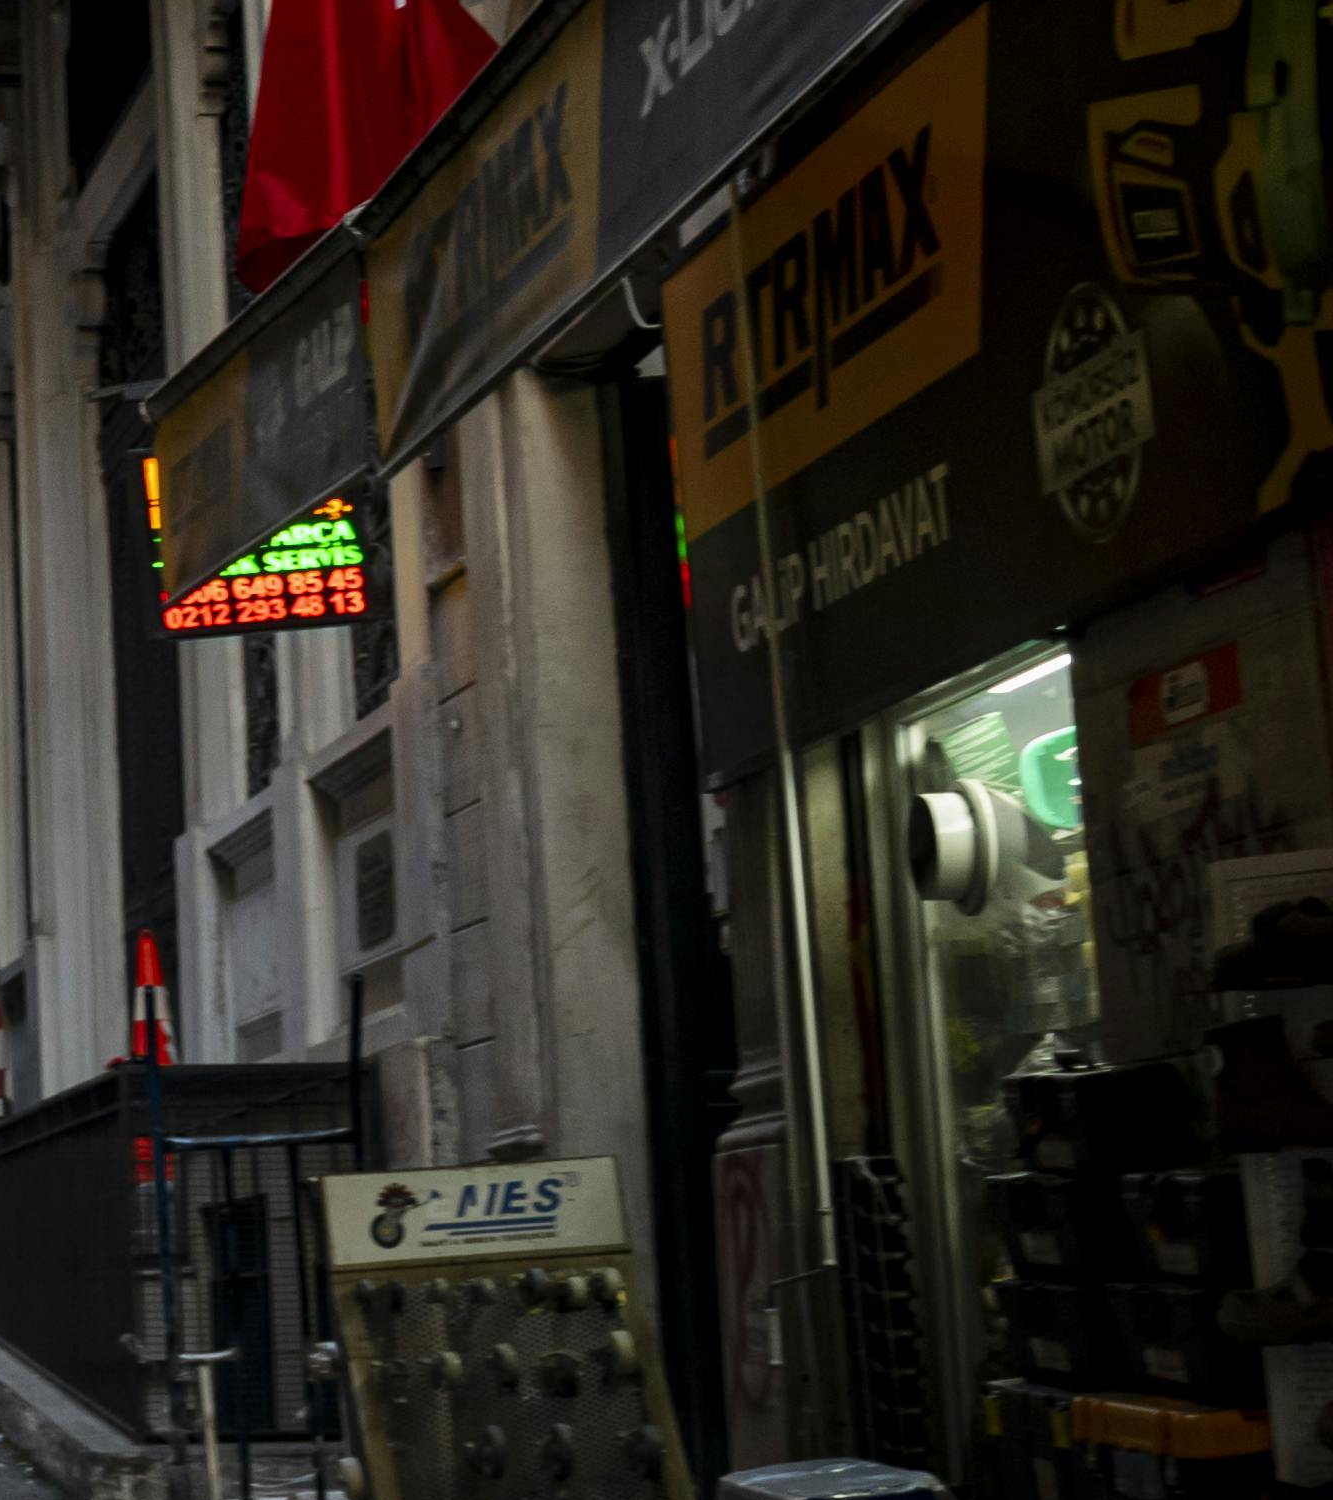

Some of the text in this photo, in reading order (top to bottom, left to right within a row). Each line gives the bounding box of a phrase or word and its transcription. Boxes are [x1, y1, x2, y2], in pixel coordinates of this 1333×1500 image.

[1052, 397, 1139, 475] MOTOR
[261, 519, 357, 548] ARÇA
[806, 462, 950, 612] HIRDAVAT
[262, 544, 364, 572] SERVİS
[233, 574, 284, 601] 649
[287, 570, 324, 595] 85
[327, 567, 365, 590] 45
[164, 590, 365, 630] 0212 293 48 13
